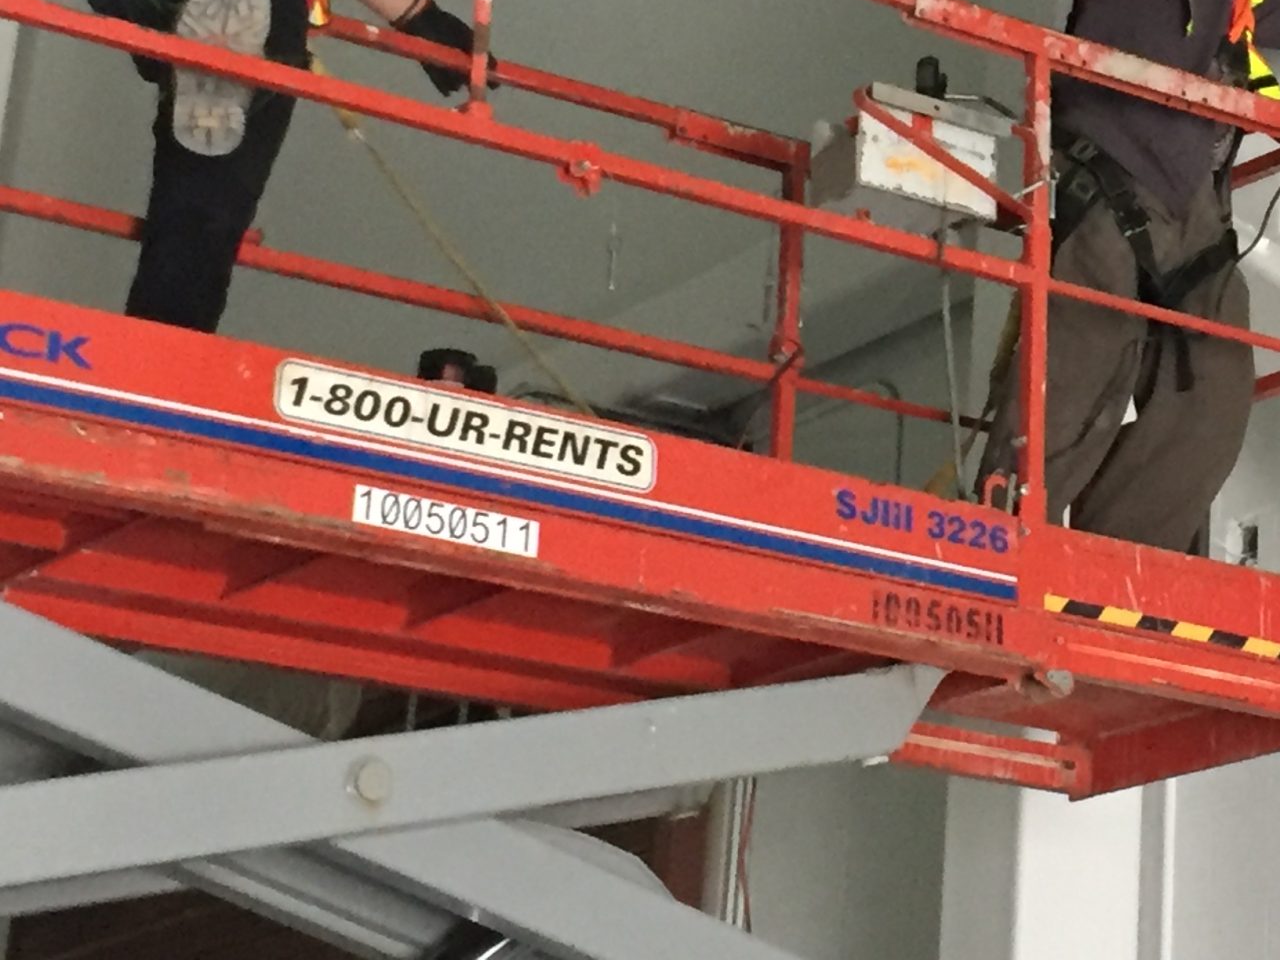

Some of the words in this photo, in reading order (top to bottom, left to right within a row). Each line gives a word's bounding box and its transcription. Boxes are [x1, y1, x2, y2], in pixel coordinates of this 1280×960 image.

[0, 323, 93, 371] CK
[287, 376, 644, 478] 1-800-UR-RENTS
[360, 489, 531, 553] 10050511
[927, 510, 1009, 554] 3226
